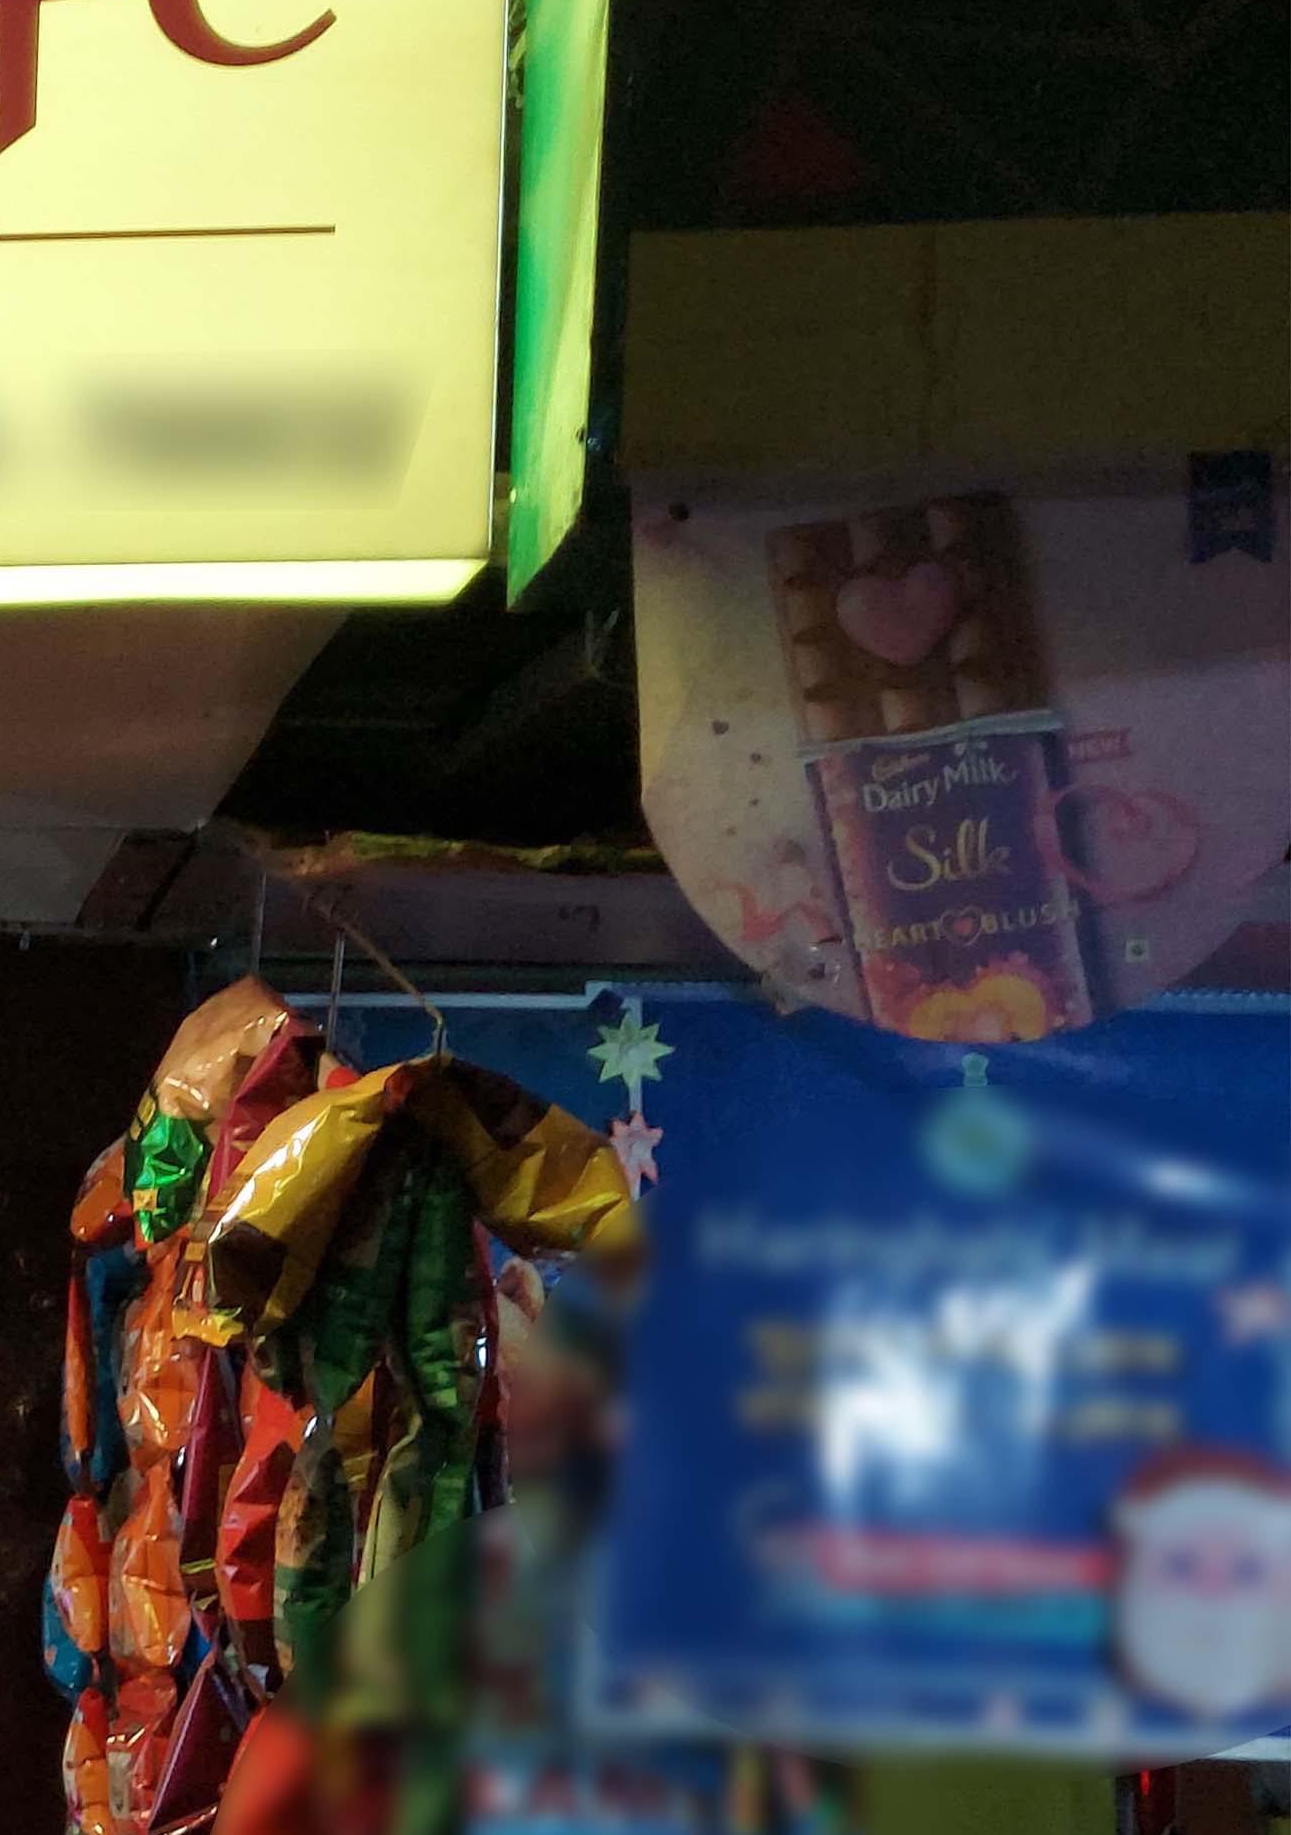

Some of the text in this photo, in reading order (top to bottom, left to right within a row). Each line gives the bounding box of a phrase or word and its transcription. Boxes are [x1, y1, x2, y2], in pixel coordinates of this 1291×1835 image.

[862, 776, 940, 813] Dairy
[943, 753, 1016, 793] Milk
[887, 816, 1012, 892] Silk
